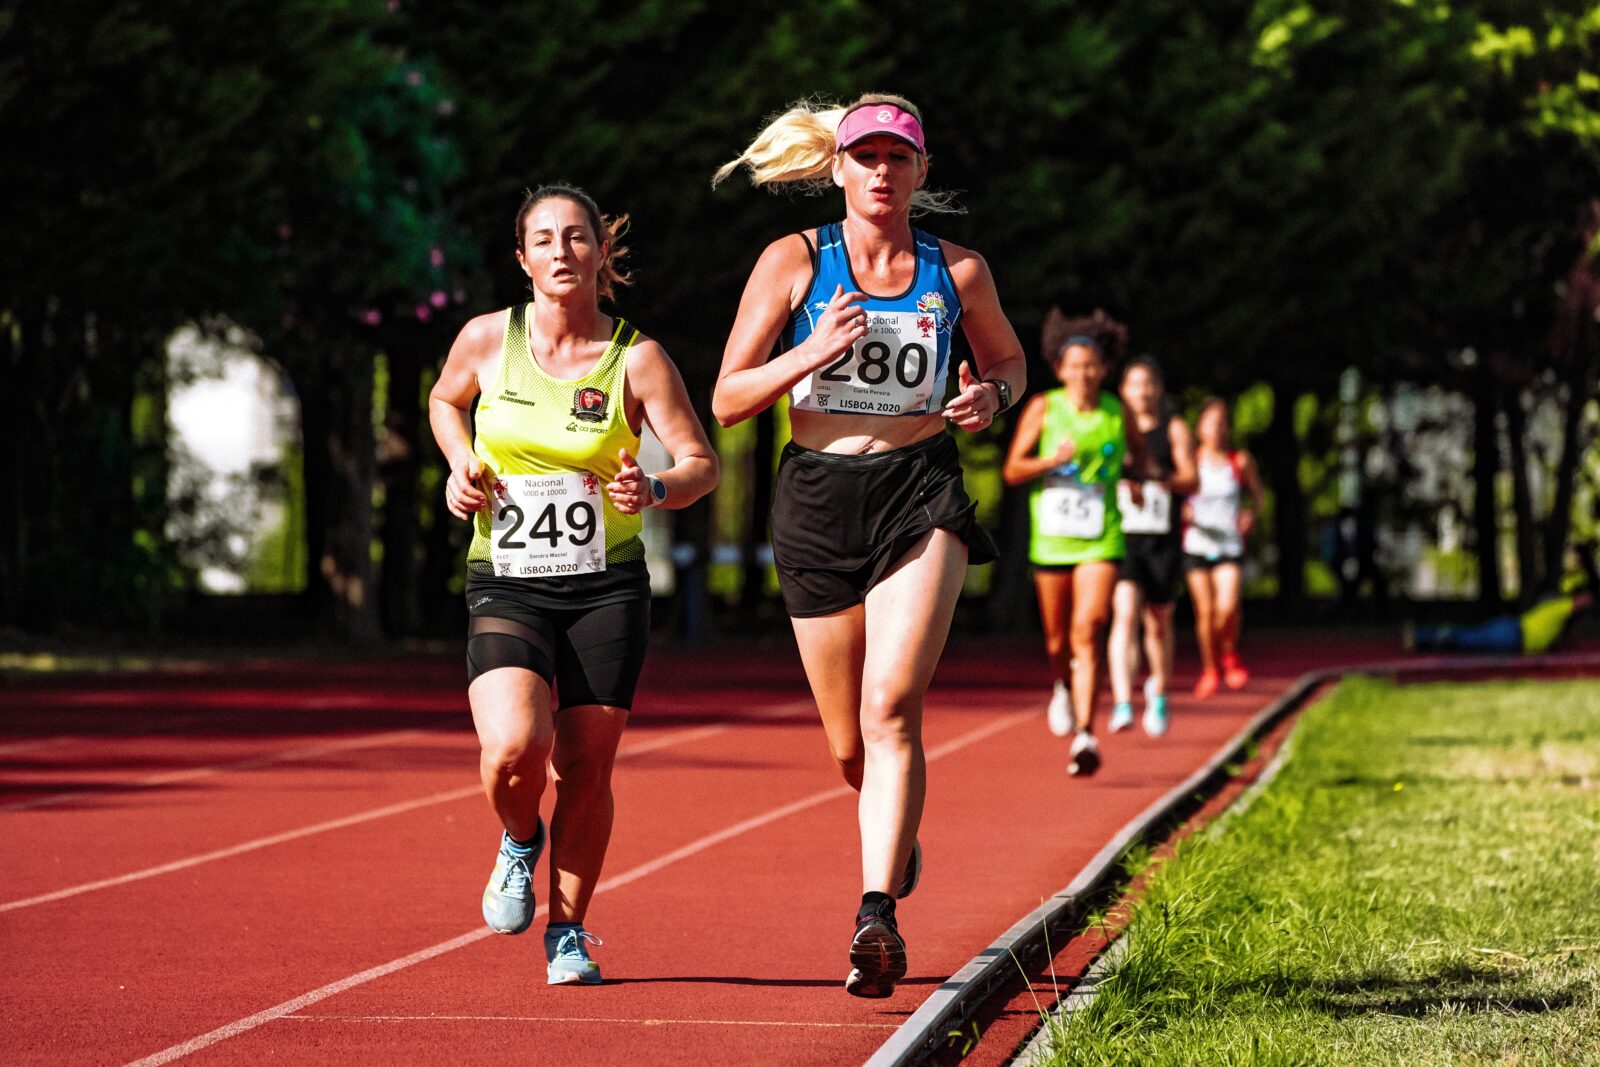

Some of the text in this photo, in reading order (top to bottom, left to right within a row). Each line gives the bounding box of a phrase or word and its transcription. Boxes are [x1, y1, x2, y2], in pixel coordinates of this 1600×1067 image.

[866, 315, 899, 325] acional
[880, 327, 902, 335] 10000
[819, 341, 928, 389] 280
[504, 389, 518, 397] Team
[853, 387, 891, 397] Carla Pereira
[839, 399, 900, 413] LISBOA 2020
[524, 478, 564, 488] Nacional
[547, 488, 568, 497] 10000
[498, 500, 597, 550] 249
[528, 552, 549, 560] Sandra
[520, 563, 578, 575] LISBOA 2020
